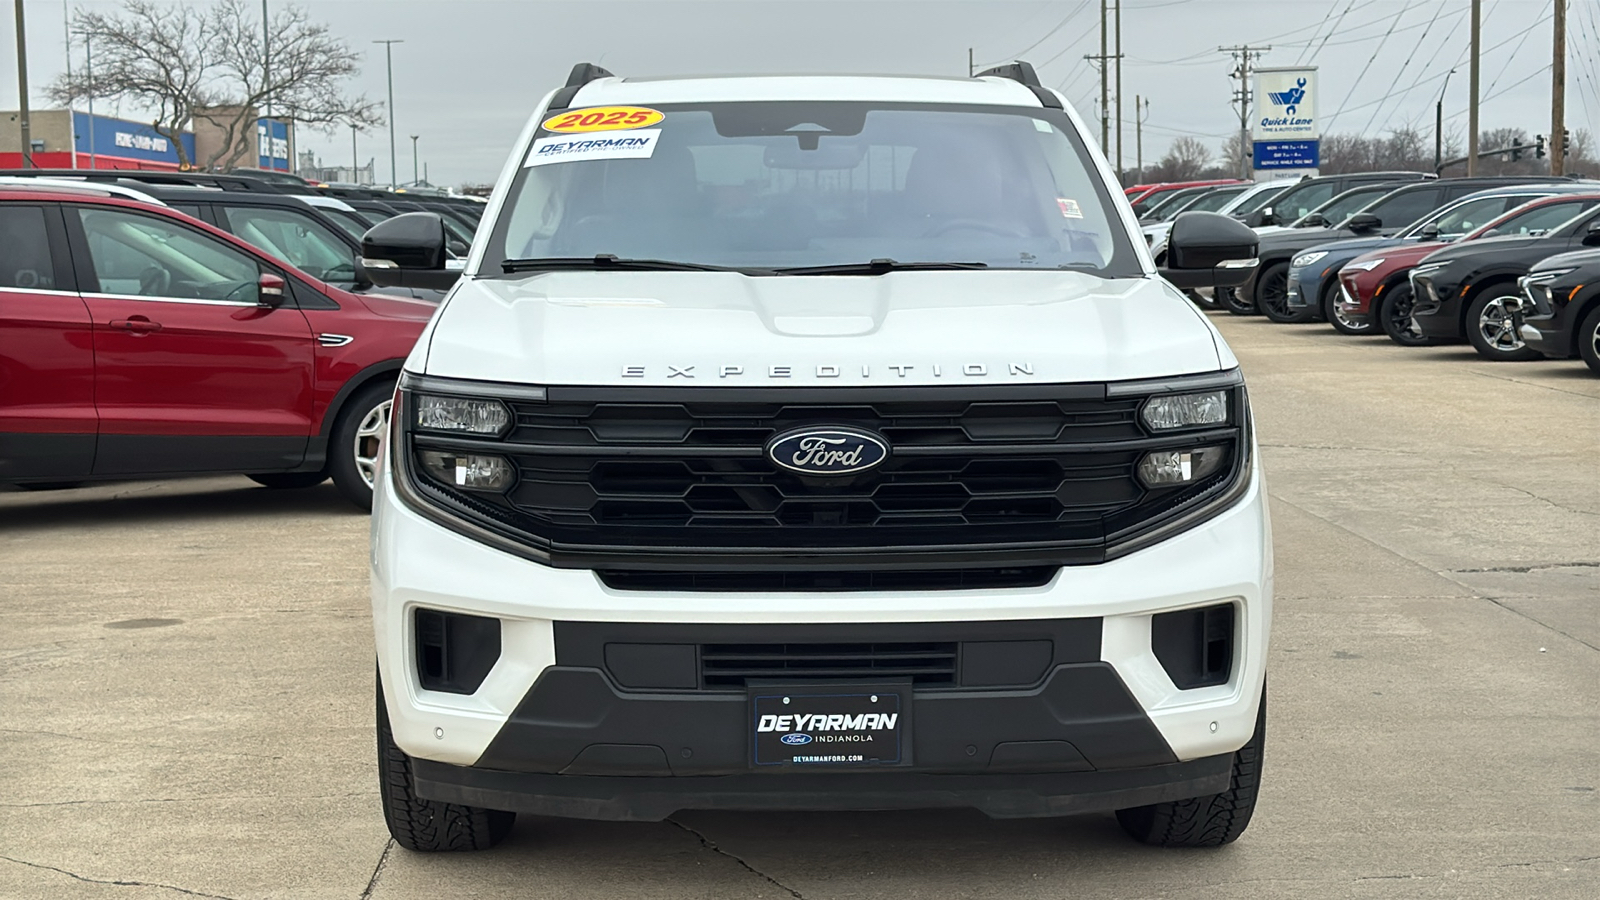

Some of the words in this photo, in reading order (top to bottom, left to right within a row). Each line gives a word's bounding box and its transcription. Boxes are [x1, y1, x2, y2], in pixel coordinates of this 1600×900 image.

[553, 111, 653, 129] 2025
[1260, 117, 1288, 127] Quick
[1289, 117, 1313, 125] Lane
[538, 137, 651, 154] DEYARMAN
[544, 148, 589, 156] CERTIFIED
[621, 362, 1034, 379] EXPEDITION
[792, 437, 864, 467] Ford
[757, 713, 898, 733] DEYARMAN
[786, 735, 806, 744] Ford
[815, 734, 874, 743] INDIANOLA
[793, 754, 863, 763] DEYARMANFORD.COM
